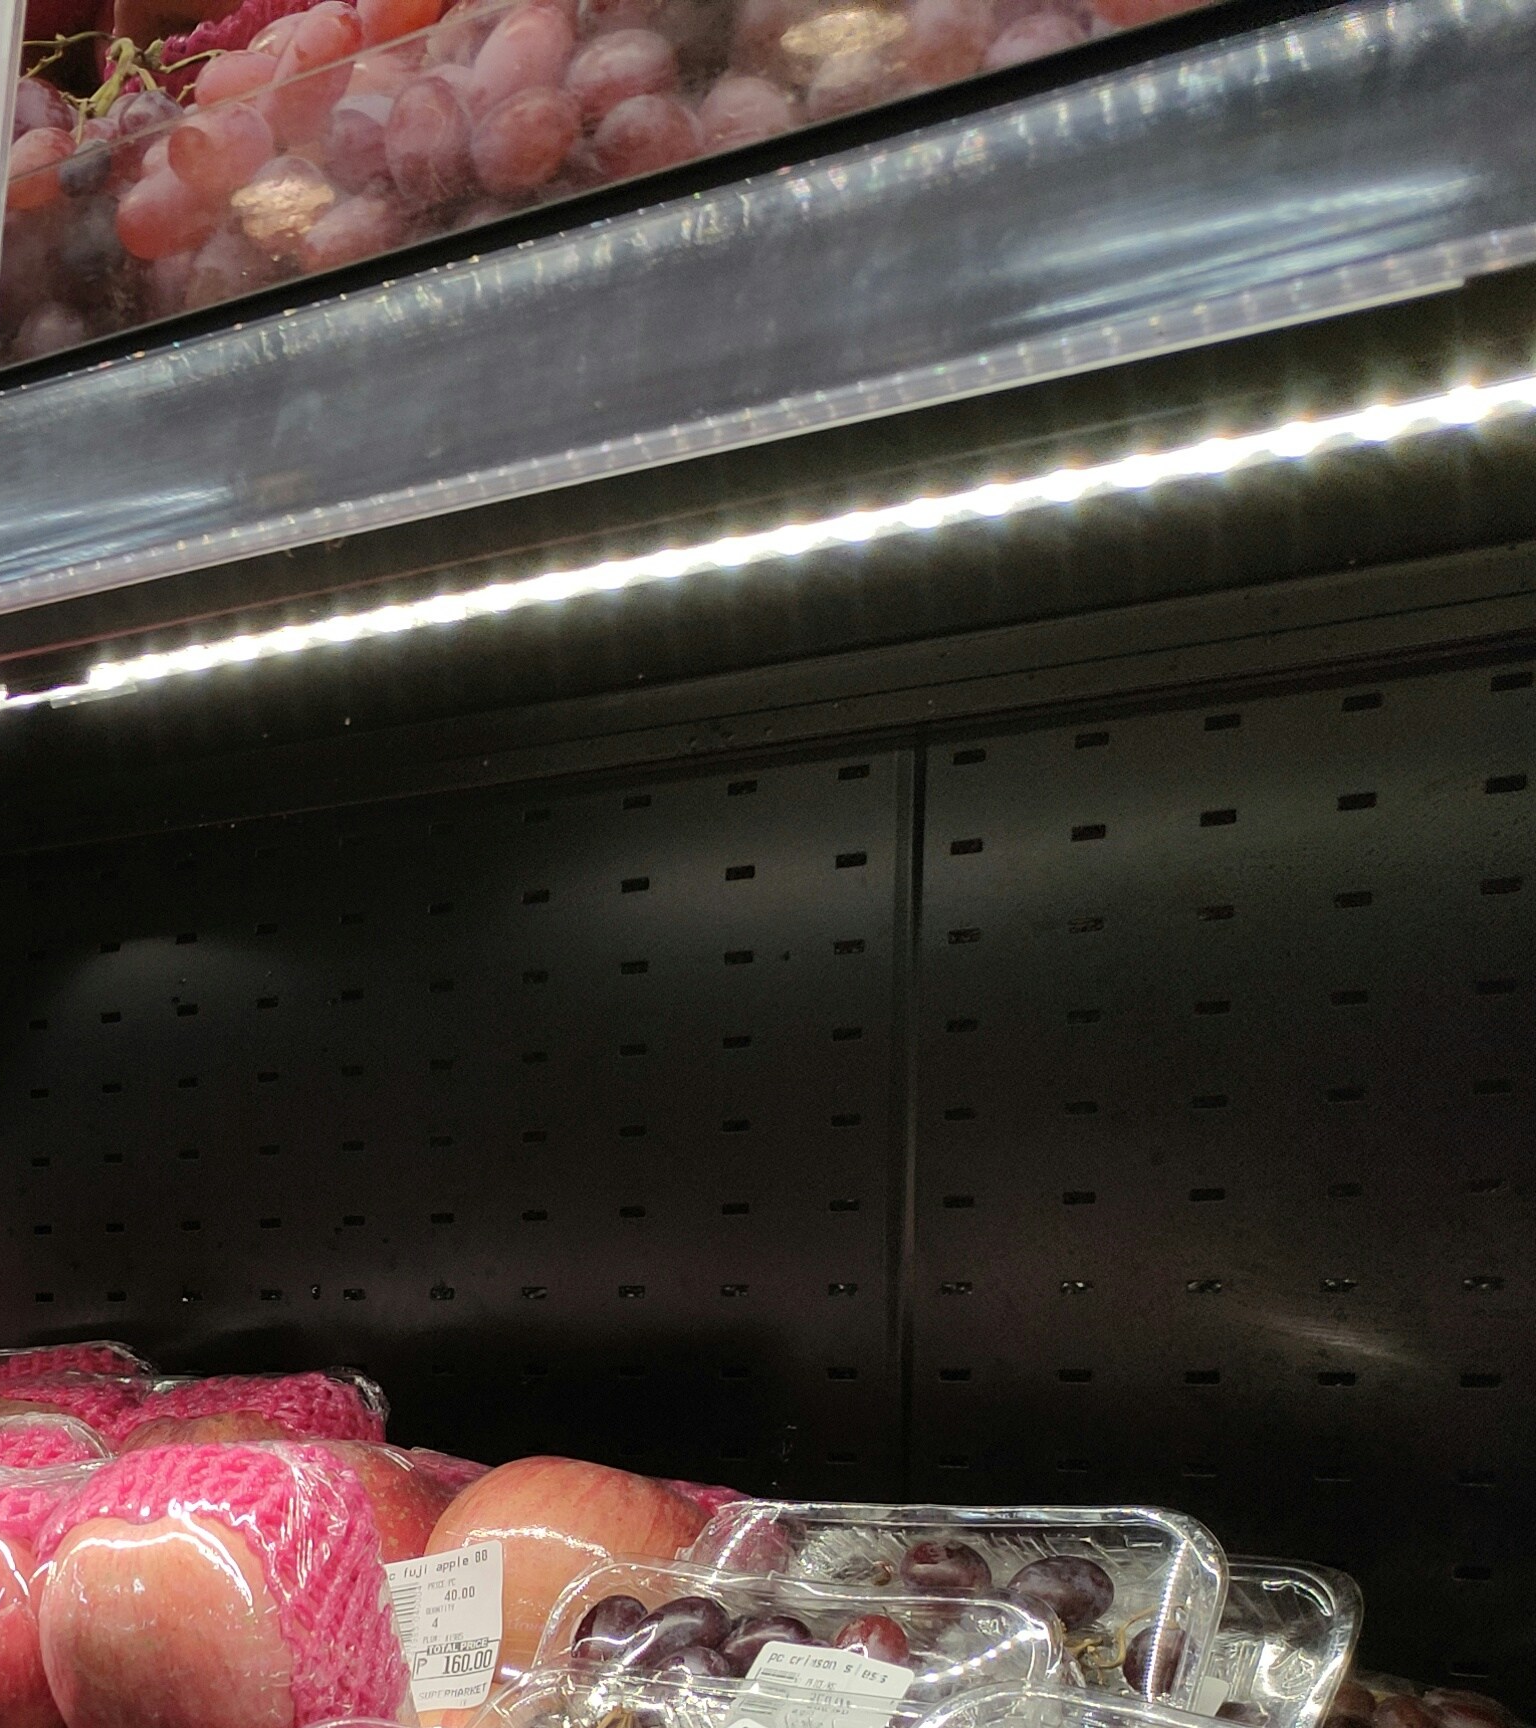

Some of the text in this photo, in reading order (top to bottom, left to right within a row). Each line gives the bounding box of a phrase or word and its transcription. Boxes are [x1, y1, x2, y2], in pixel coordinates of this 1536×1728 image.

[404, 1555, 469, 1579] fuji apple
[444, 1586, 475, 1602] 40.00
[432, 1618, 439, 1628] 4
[460, 1637, 489, 1651] PRICE
[443, 1649, 493, 1675] 160.00
[767, 1652, 783, 1663] pc
[418, 1683, 487, 1702] SUPERMARKET
